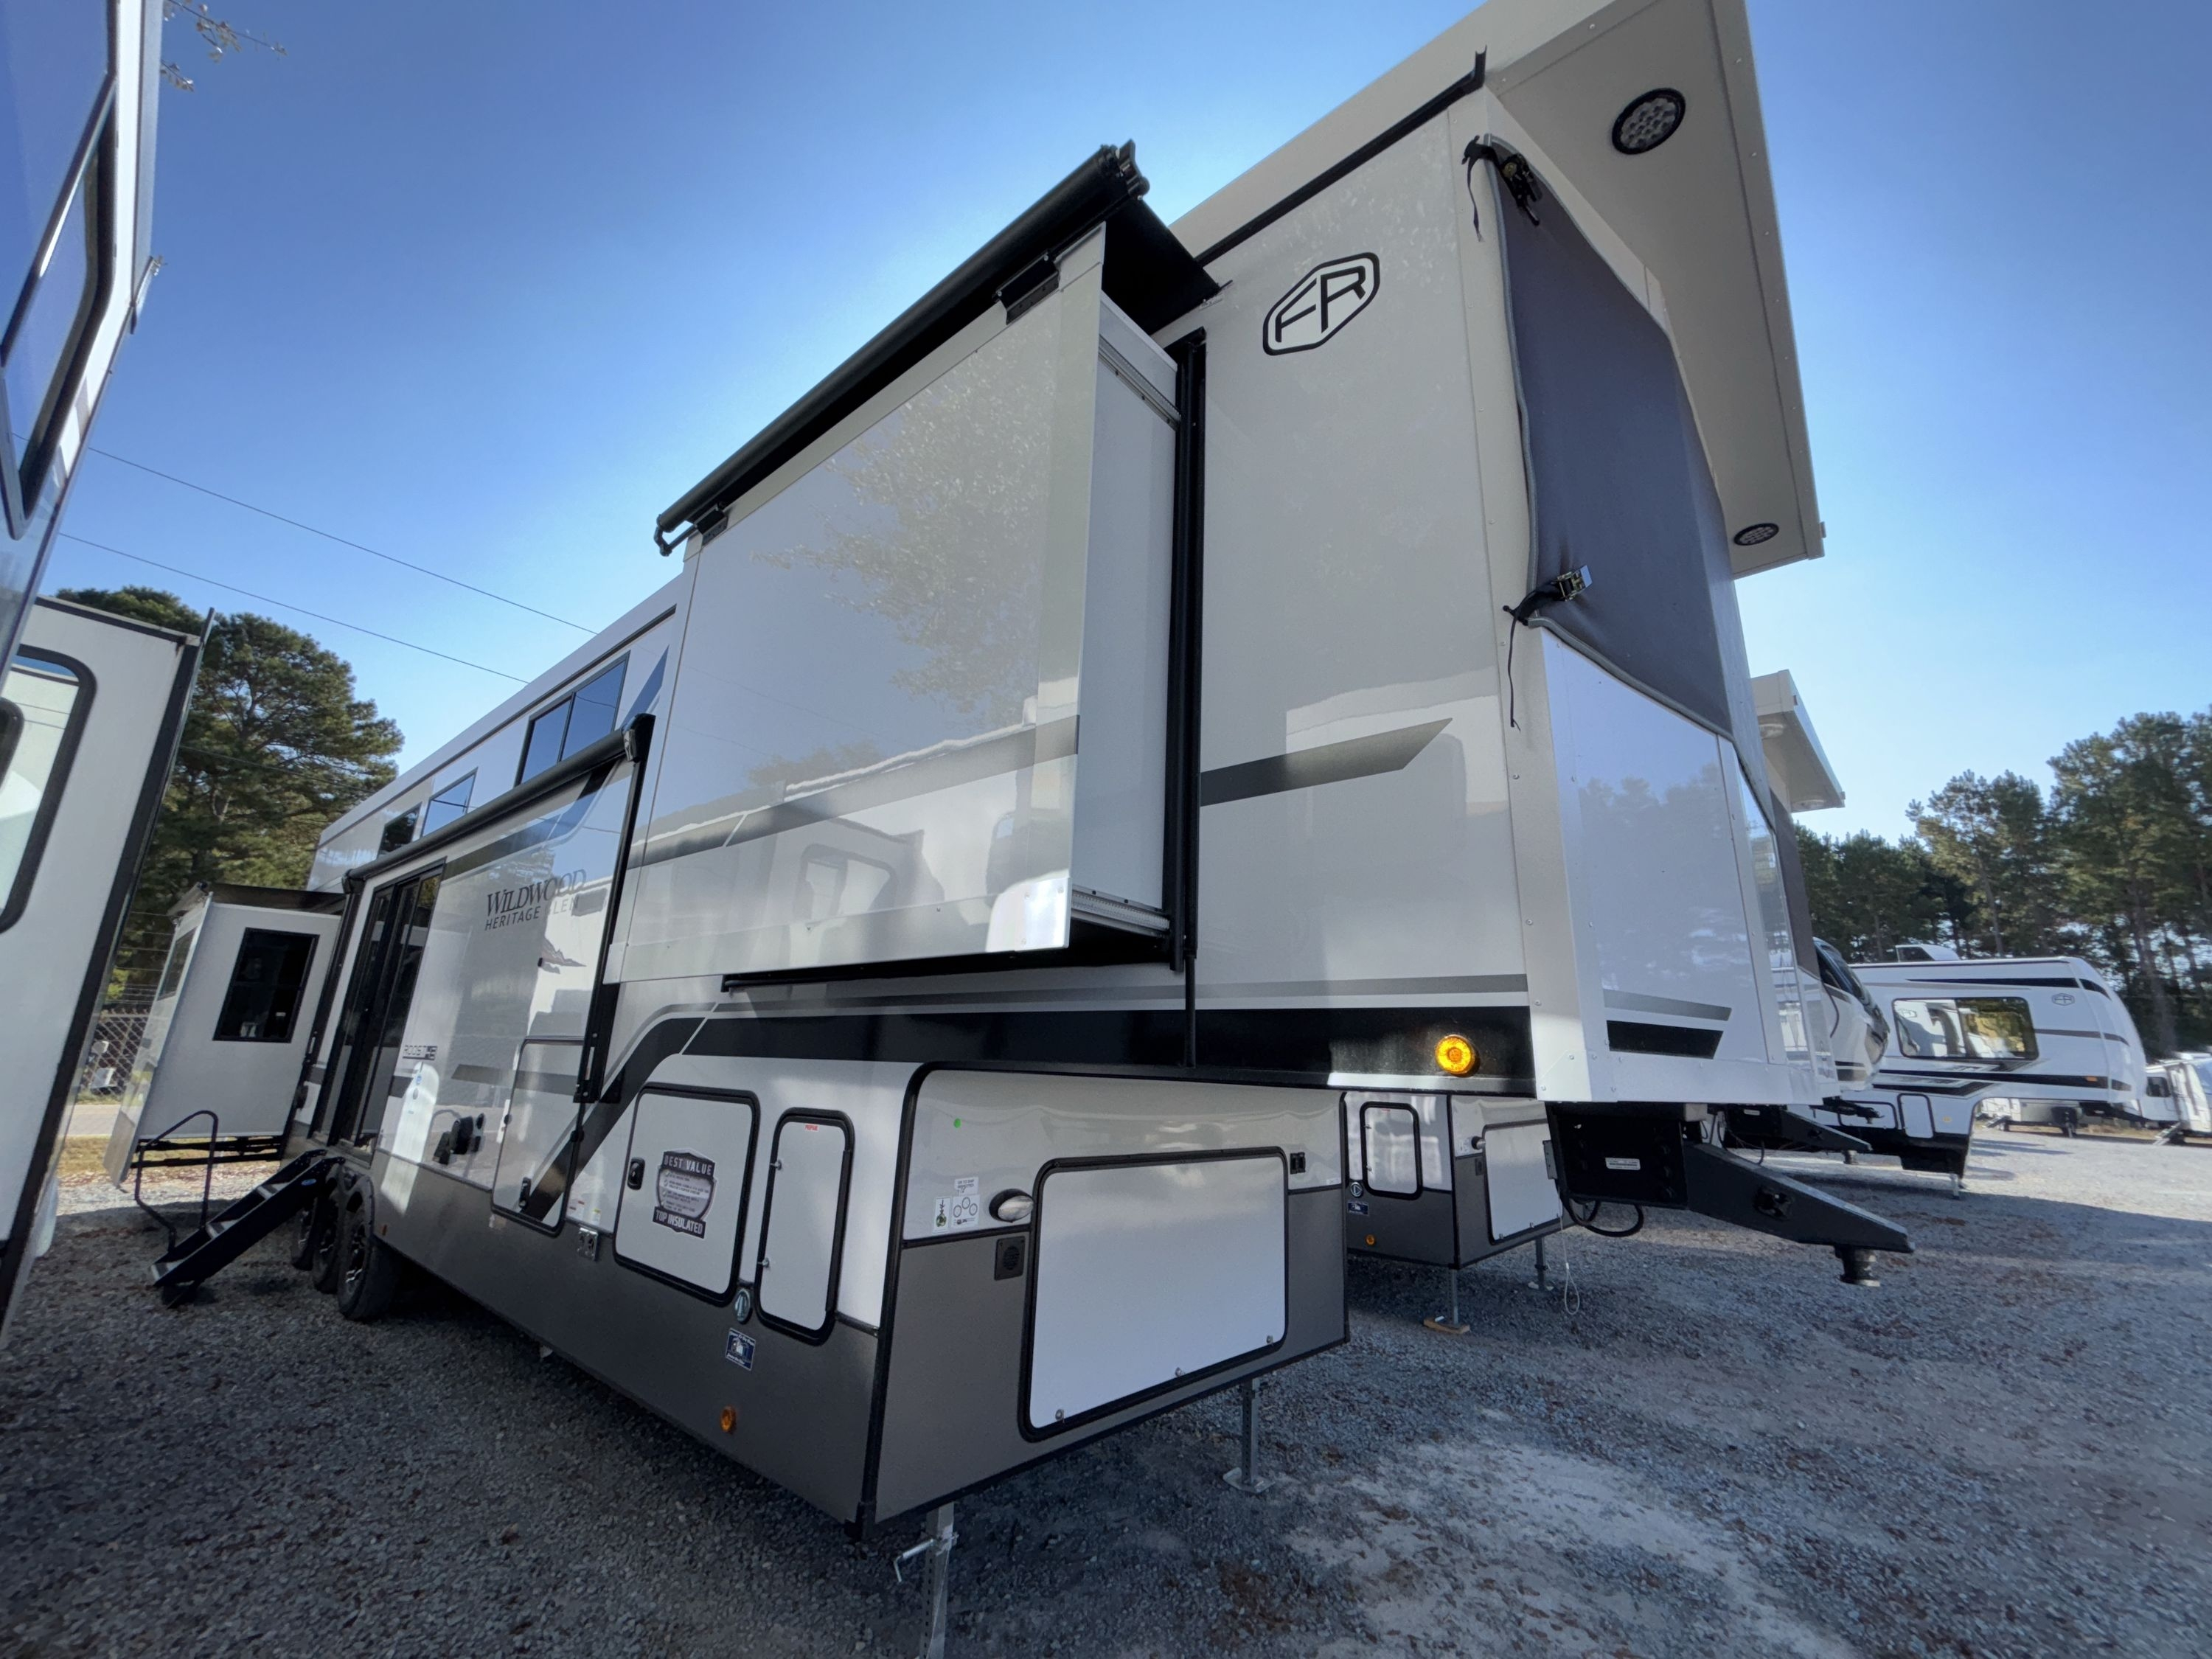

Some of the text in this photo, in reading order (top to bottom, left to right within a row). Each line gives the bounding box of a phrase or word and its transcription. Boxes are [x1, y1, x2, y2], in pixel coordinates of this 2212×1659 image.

[1275, 265, 1366, 344] FR
[484, 905, 541, 931] HERITAGE
[664, 1155, 712, 1175] BEST VALUE
[655, 1209, 703, 1234] TOP INSULATED
